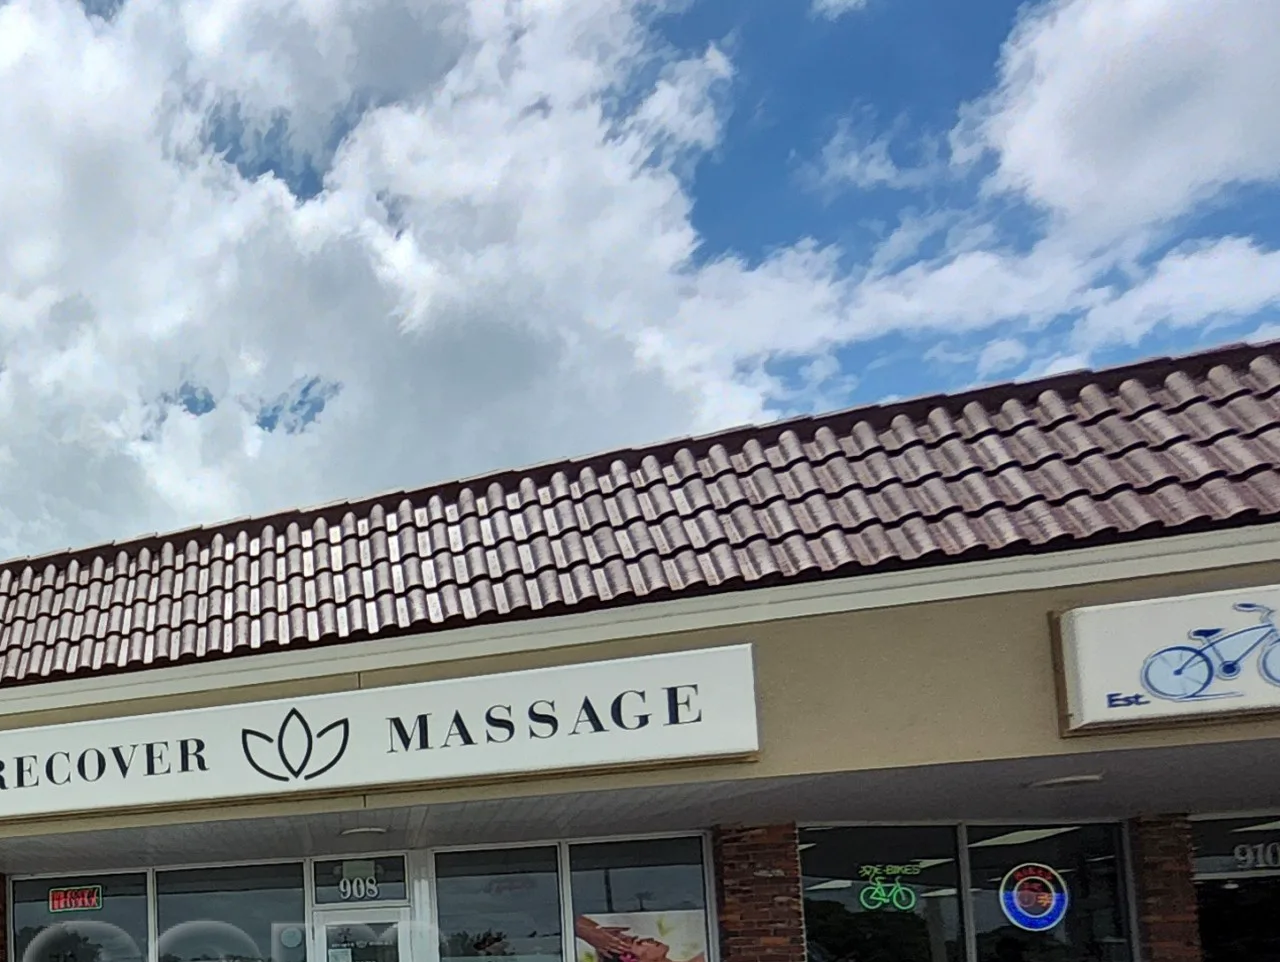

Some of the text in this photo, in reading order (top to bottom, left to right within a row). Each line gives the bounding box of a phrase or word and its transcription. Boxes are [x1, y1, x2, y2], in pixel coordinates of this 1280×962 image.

[385, 682, 703, 754] MASSAGE
[1233, 842, 1280, 869] 910
[339, 876, 378, 899] 908
